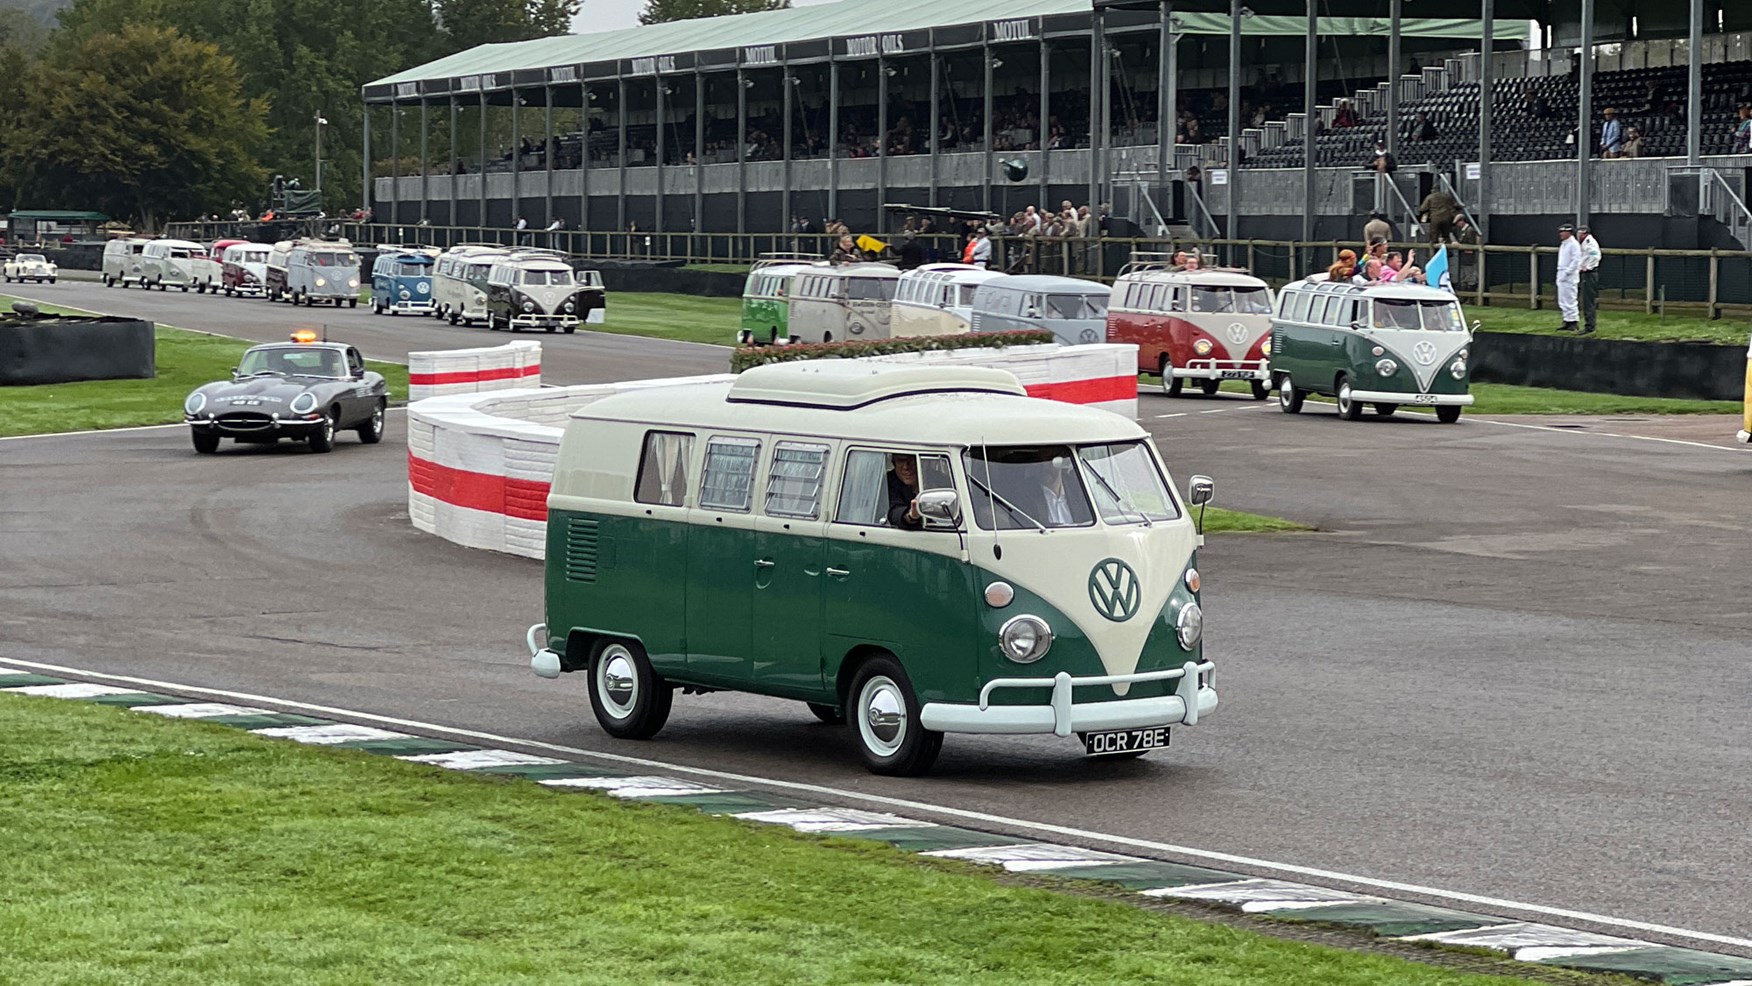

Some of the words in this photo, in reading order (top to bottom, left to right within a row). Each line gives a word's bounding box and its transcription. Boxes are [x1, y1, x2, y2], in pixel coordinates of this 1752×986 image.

[993, 20, 1032, 41] MOTUL
[846, 36, 877, 56] MOTOR
[882, 34, 904, 54] OILS
[1227, 323, 1247, 344] VW
[1413, 341, 1436, 366] VW
[1090, 558, 1140, 621] VW
[1094, 732, 1128, 752] OCR
[1132, 729, 1165, 749] 78E
